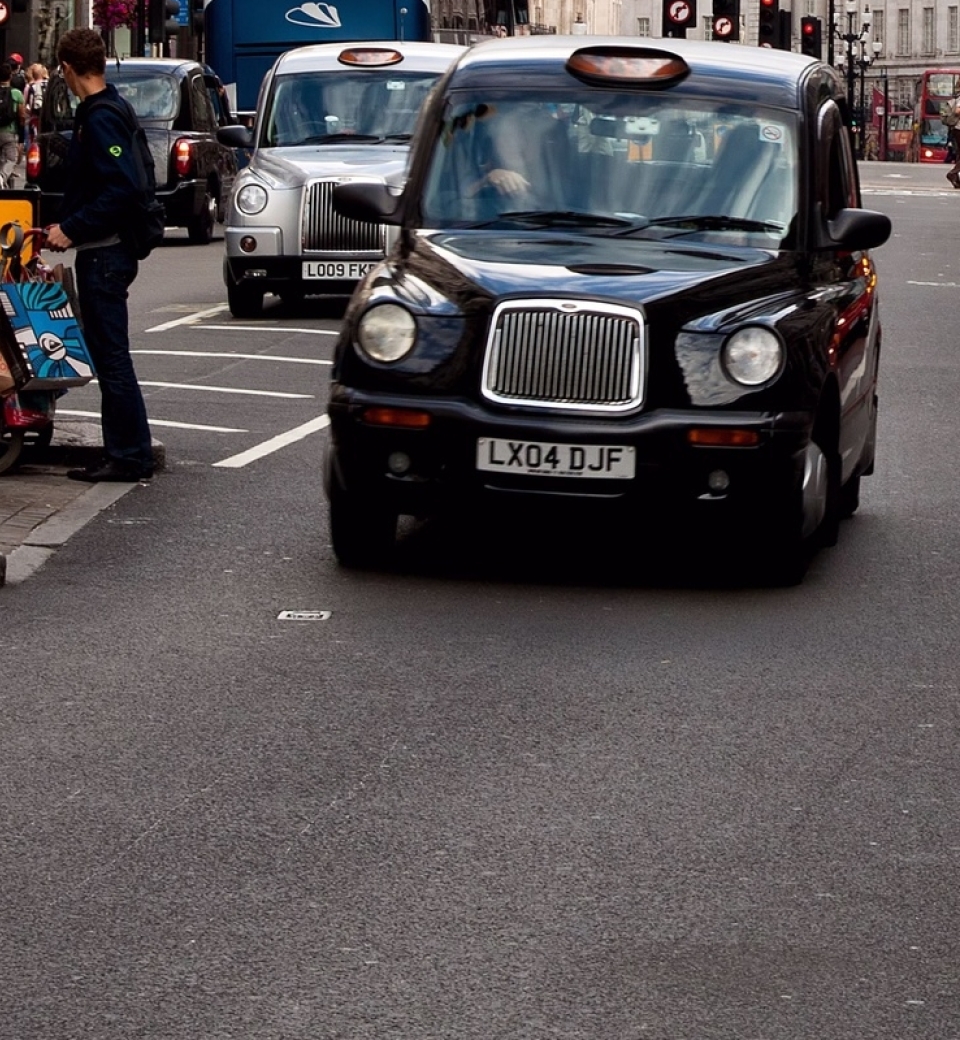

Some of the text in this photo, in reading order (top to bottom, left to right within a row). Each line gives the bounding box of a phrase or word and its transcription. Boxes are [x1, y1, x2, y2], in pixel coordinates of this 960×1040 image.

[308, 264, 345, 277] LO09
[488, 441, 622, 472] LX04 DJF
